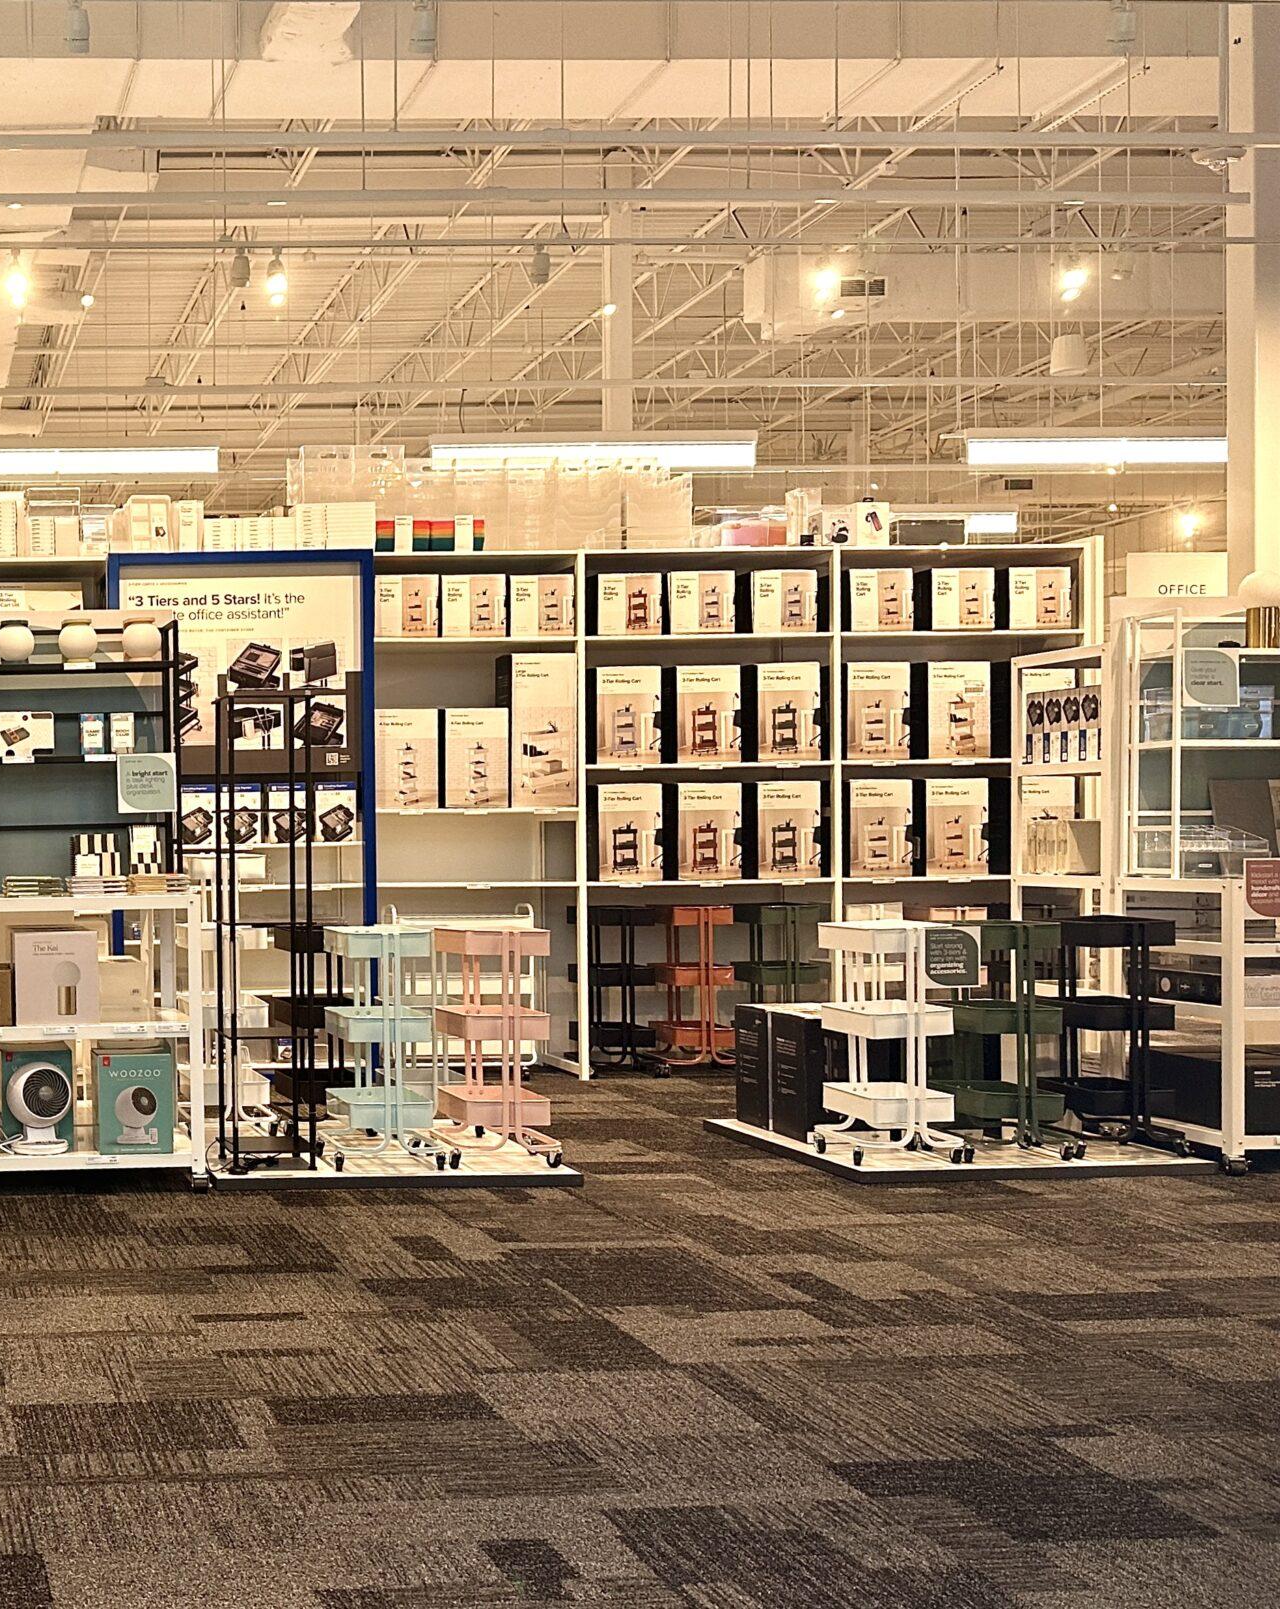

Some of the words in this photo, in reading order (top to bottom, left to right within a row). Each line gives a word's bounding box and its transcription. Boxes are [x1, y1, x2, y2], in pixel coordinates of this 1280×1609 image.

[1158, 584, 1207, 595] OFFICE
[147, 595, 179, 607] Tiers
[182, 594, 207, 606] and
[211, 594, 221, 605] 5
[224, 593, 261, 605] Stars!
[285, 593, 305, 604] the
[188, 608, 223, 620] office
[108, 1069, 161, 1078] WOOZOO
